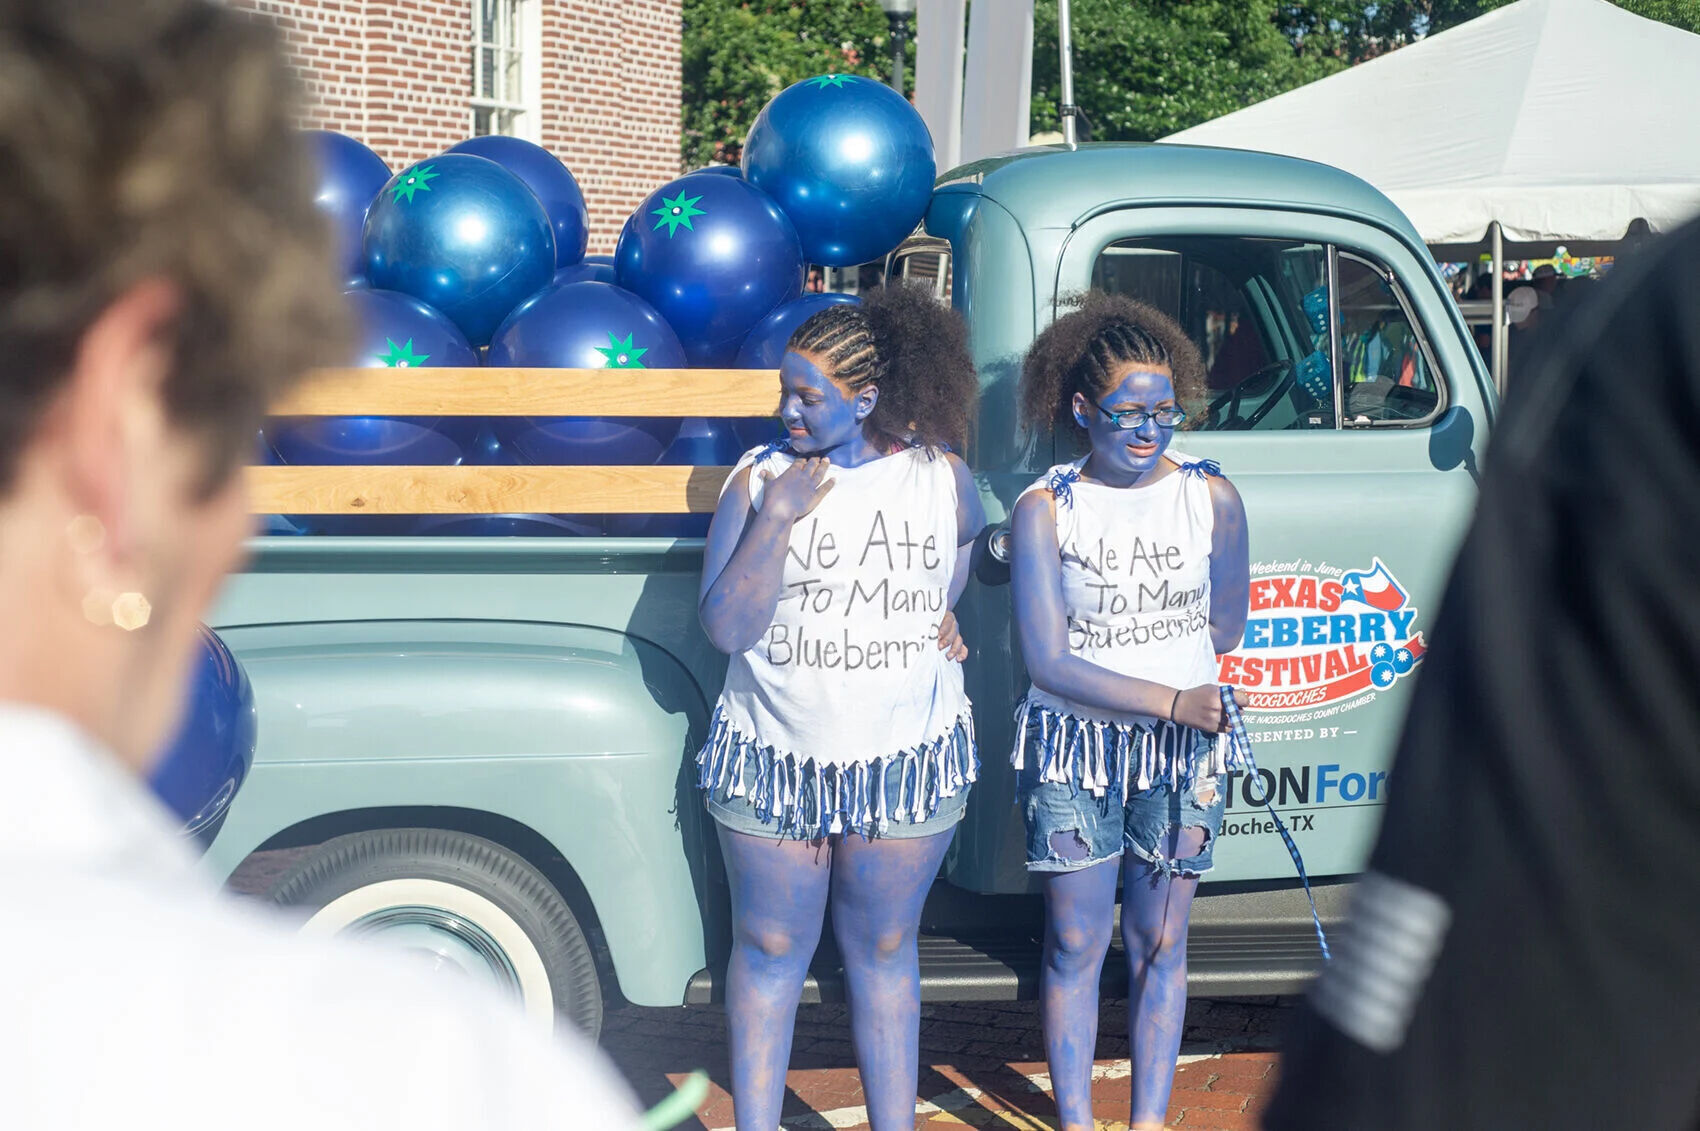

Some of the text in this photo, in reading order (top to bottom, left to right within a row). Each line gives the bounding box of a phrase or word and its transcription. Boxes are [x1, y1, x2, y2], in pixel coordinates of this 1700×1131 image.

[859, 509, 941, 572] Ate
[1071, 535, 1185, 579] We Ate
[1249, 558, 1343, 577] Weekend in June
[786, 578, 834, 614] To
[1085, 582, 1128, 615] To
[1215, 644, 1370, 687] ESTIVAL
[1245, 686, 1328, 707] ACOGDOCHES
[1256, 712, 1313, 725] NACOGDOCHES
[1313, 705, 1341, 720] COUNTY
[1340, 692, 1377, 713] CHAMBER
[1319, 727, 1340, 739] BY
